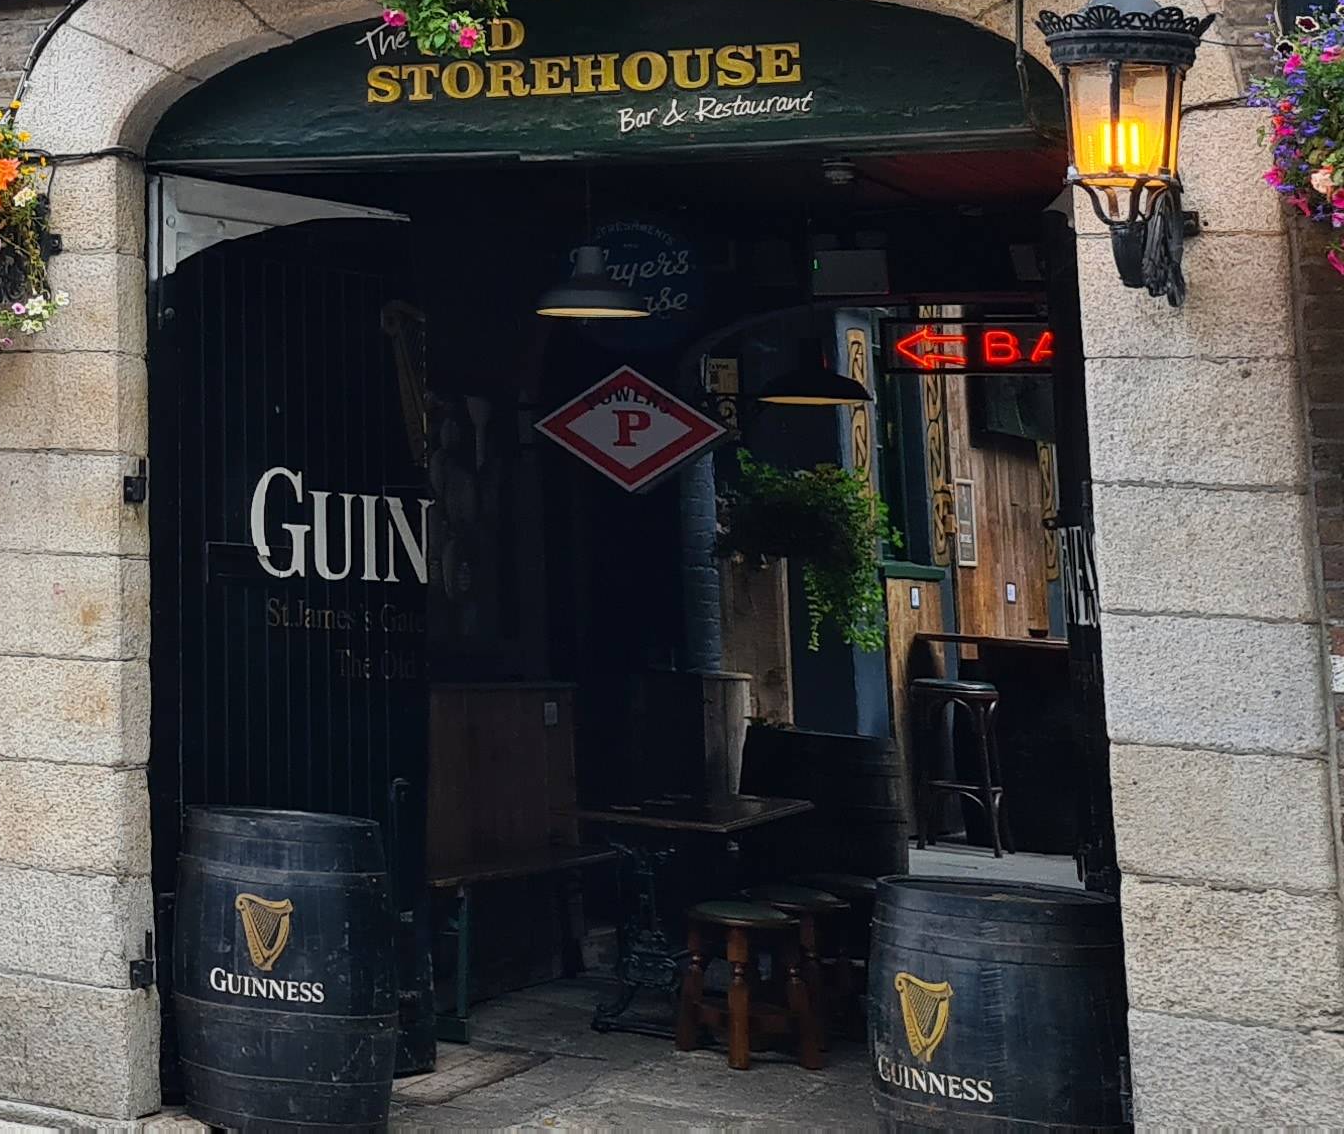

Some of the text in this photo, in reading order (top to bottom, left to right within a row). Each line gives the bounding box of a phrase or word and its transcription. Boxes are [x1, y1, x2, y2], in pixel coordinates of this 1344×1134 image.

[355, 21, 410, 60] The
[367, 42, 801, 103] STOREHOUSE
[617, 91, 814, 133] Bar & Restaurant
[611, 410, 652, 447] P
[209, 967, 324, 1003] GUINNESS
[878, 1059, 994, 1103] GUINNESS
